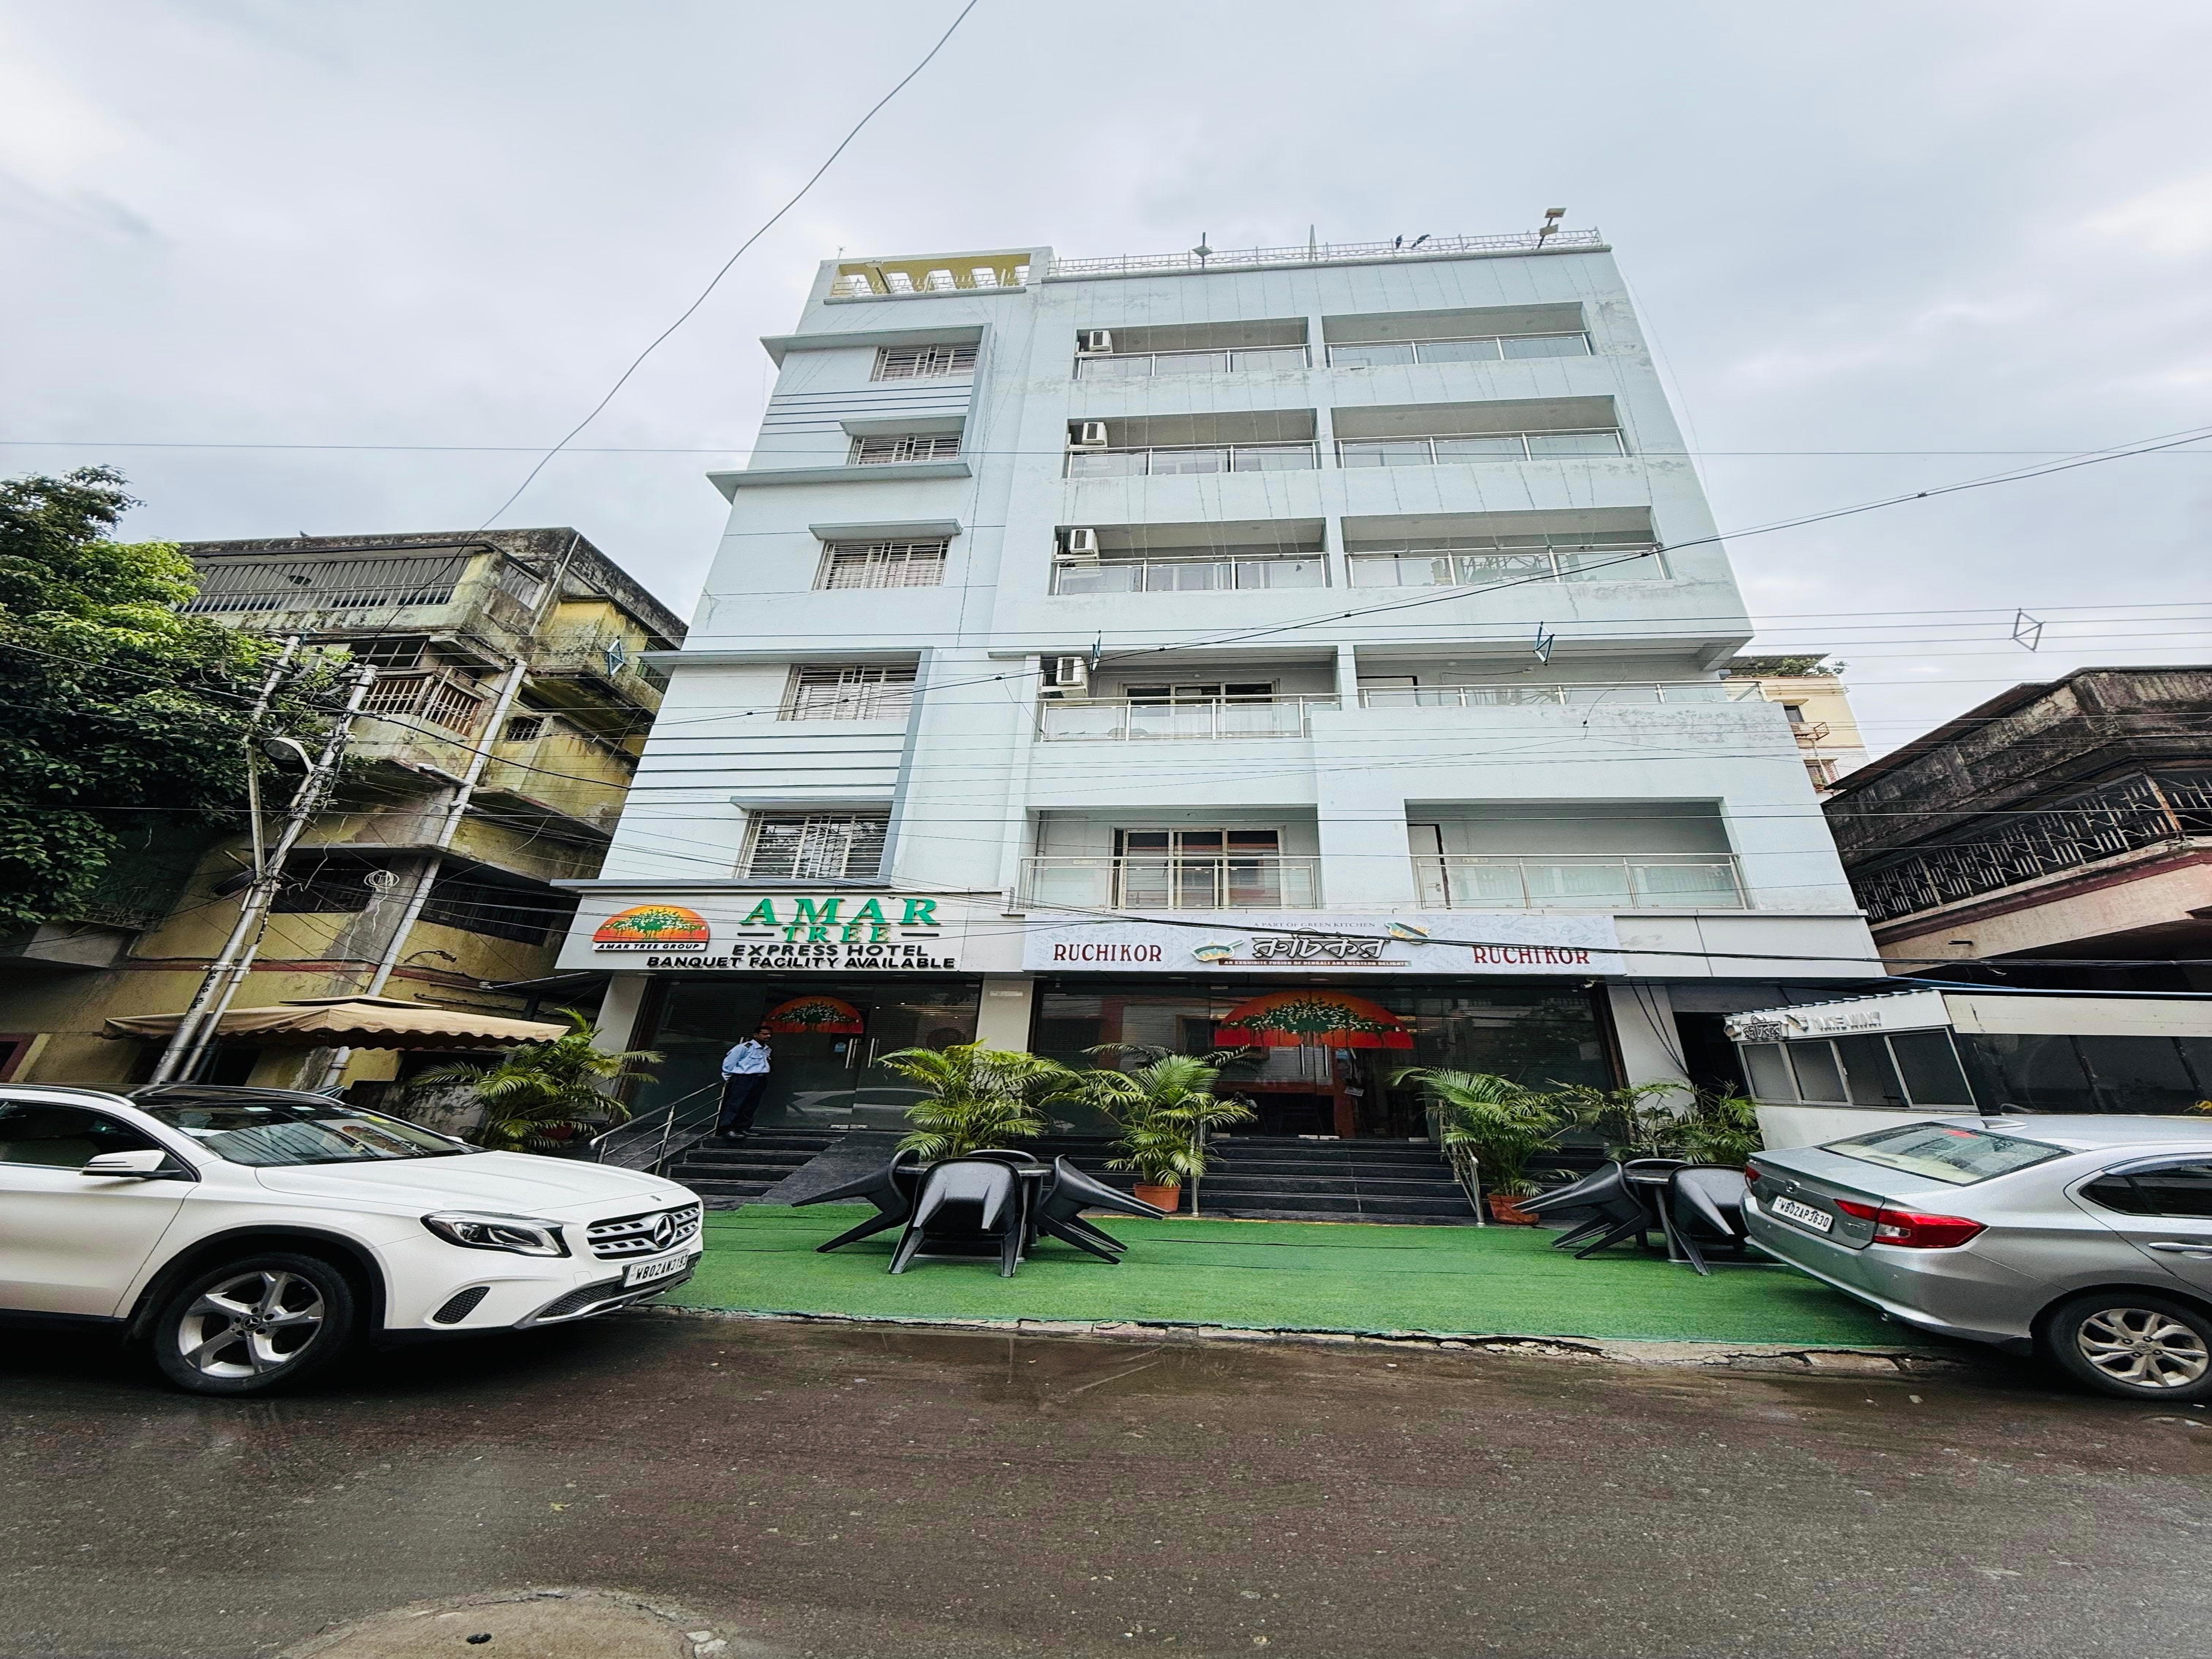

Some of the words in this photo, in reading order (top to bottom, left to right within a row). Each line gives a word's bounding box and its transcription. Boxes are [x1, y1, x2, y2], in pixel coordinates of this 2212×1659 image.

[739, 898, 941, 925] AMAR
[782, 925, 892, 943] TREE
[732, 945, 838, 956] EXPRESS
[846, 945, 928, 956] HOTEL
[1053, 944, 1162, 962] RUCHIKOR
[1472, 945, 1590, 964] RUCHIKOR
[646, 956, 742, 967] BANQUET
[749, 957, 840, 968] FACILITY
[844, 957, 955, 968] AVAILABLE
[1780, 1200, 1830, 1227] WB02AP3630
